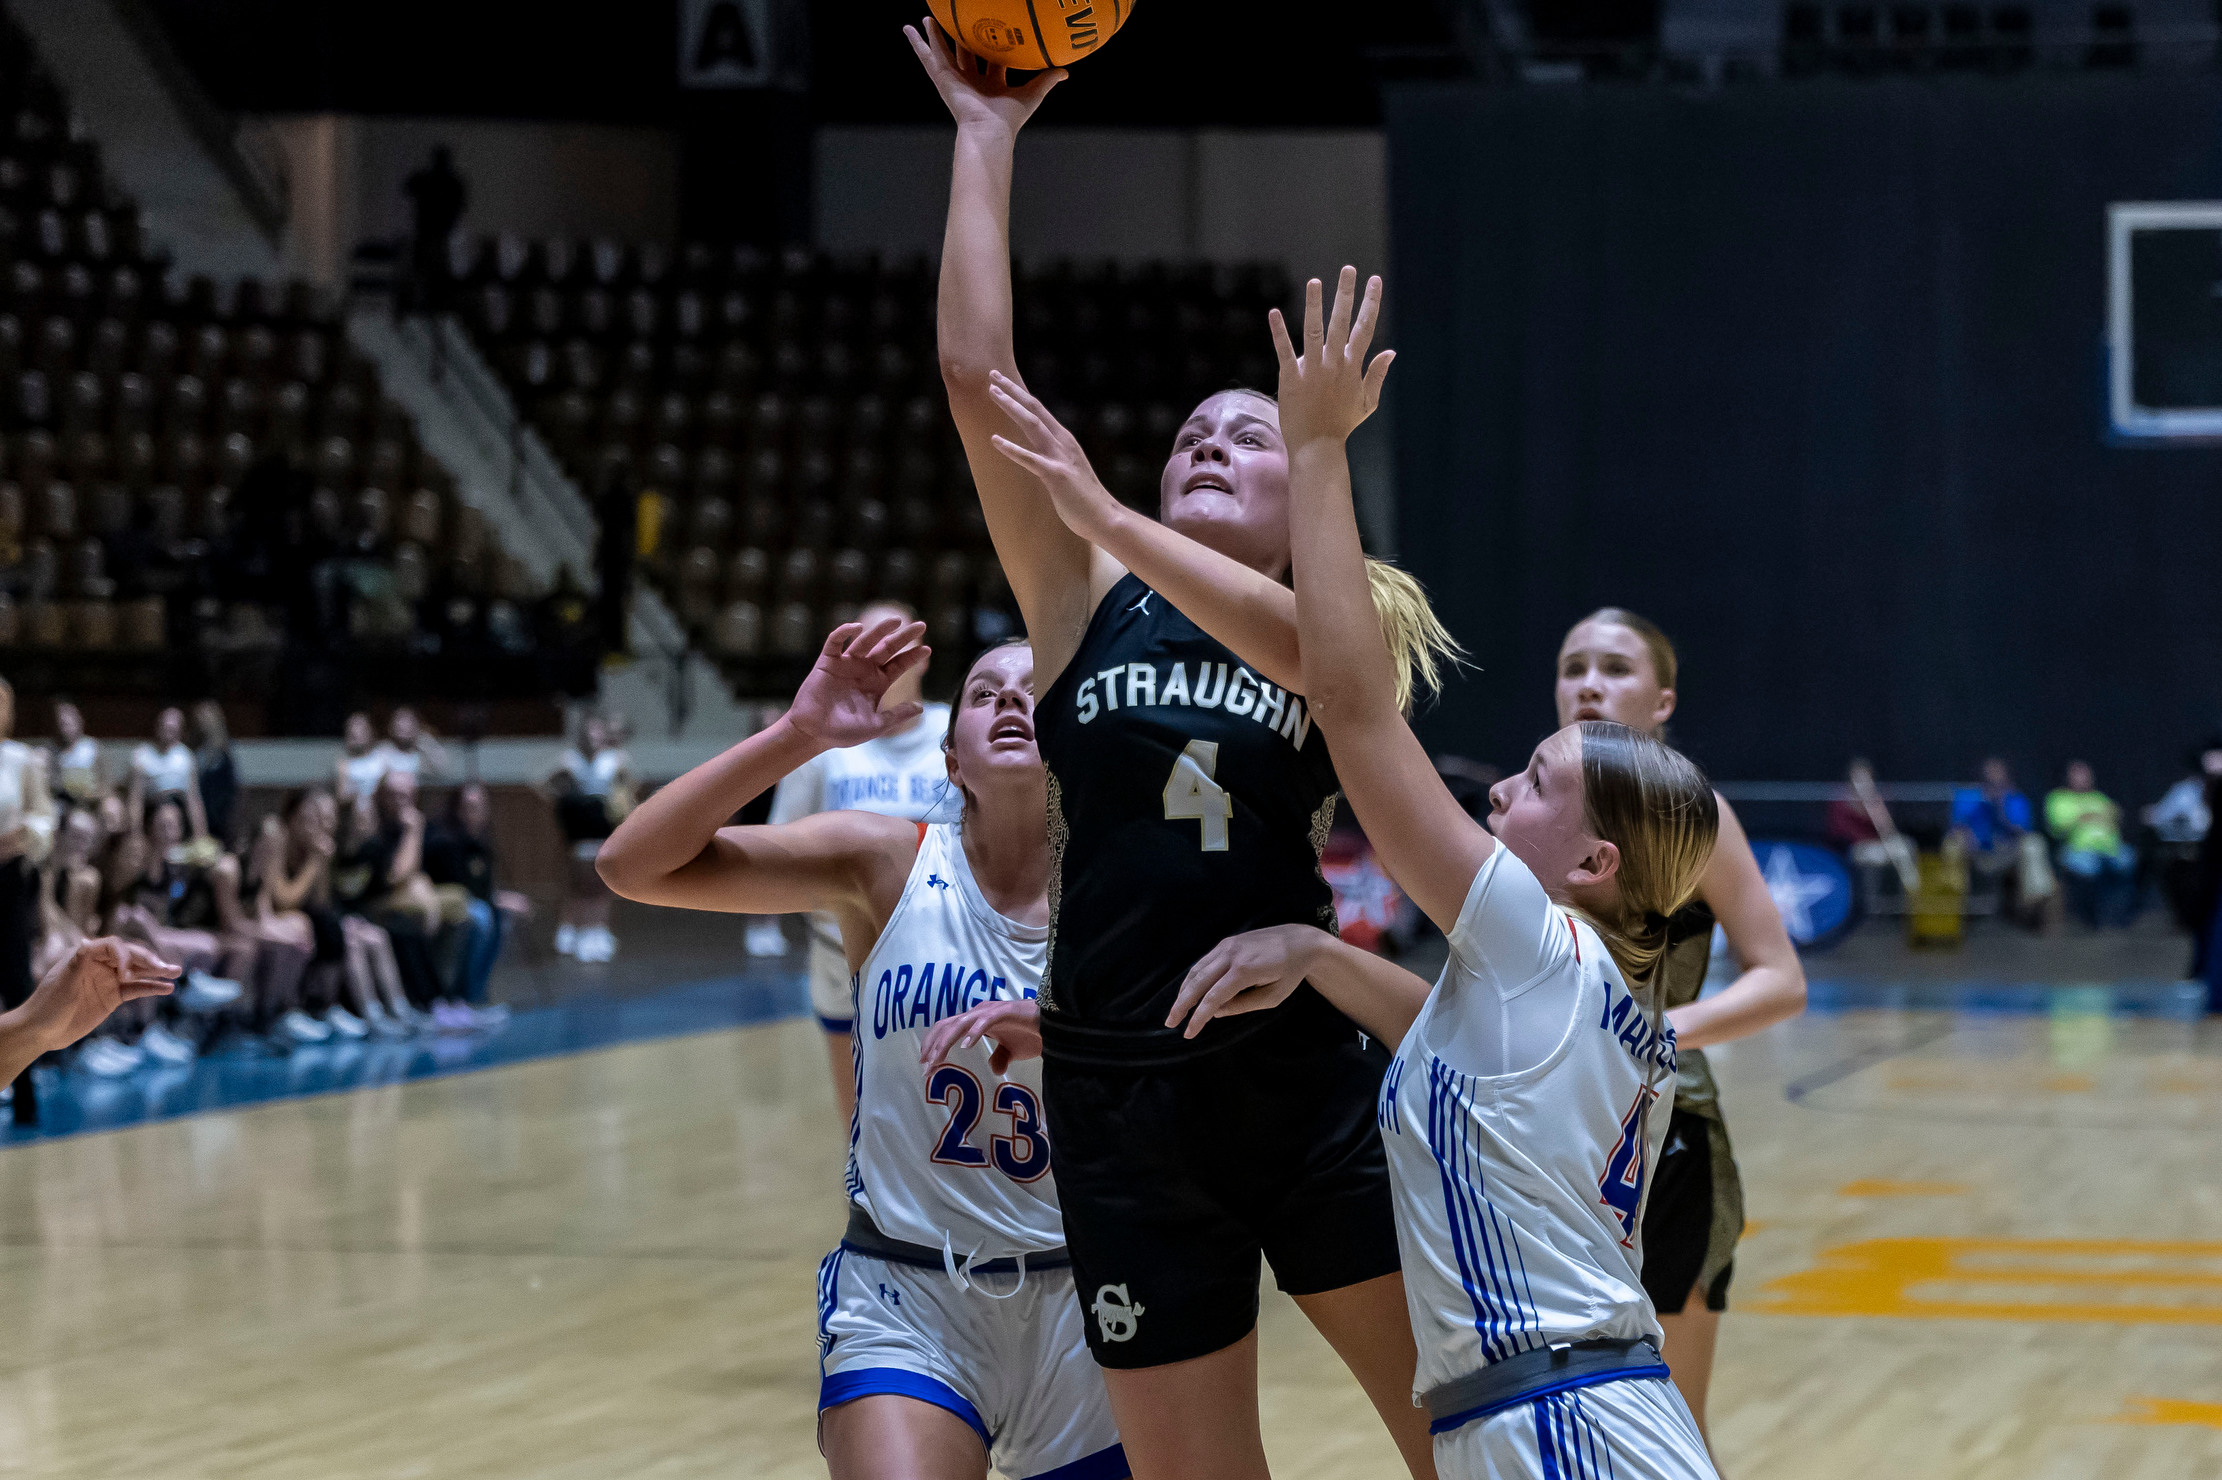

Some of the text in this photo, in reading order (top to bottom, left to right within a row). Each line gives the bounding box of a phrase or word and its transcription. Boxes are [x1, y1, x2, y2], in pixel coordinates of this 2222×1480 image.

[696, 2, 757, 70] A
[1076, 661, 1311, 751] STRAUGHN
[1162, 738, 1233, 851] 4
[925, 1063, 1051, 1184] 23
[1598, 1082, 1660, 1250] 4
